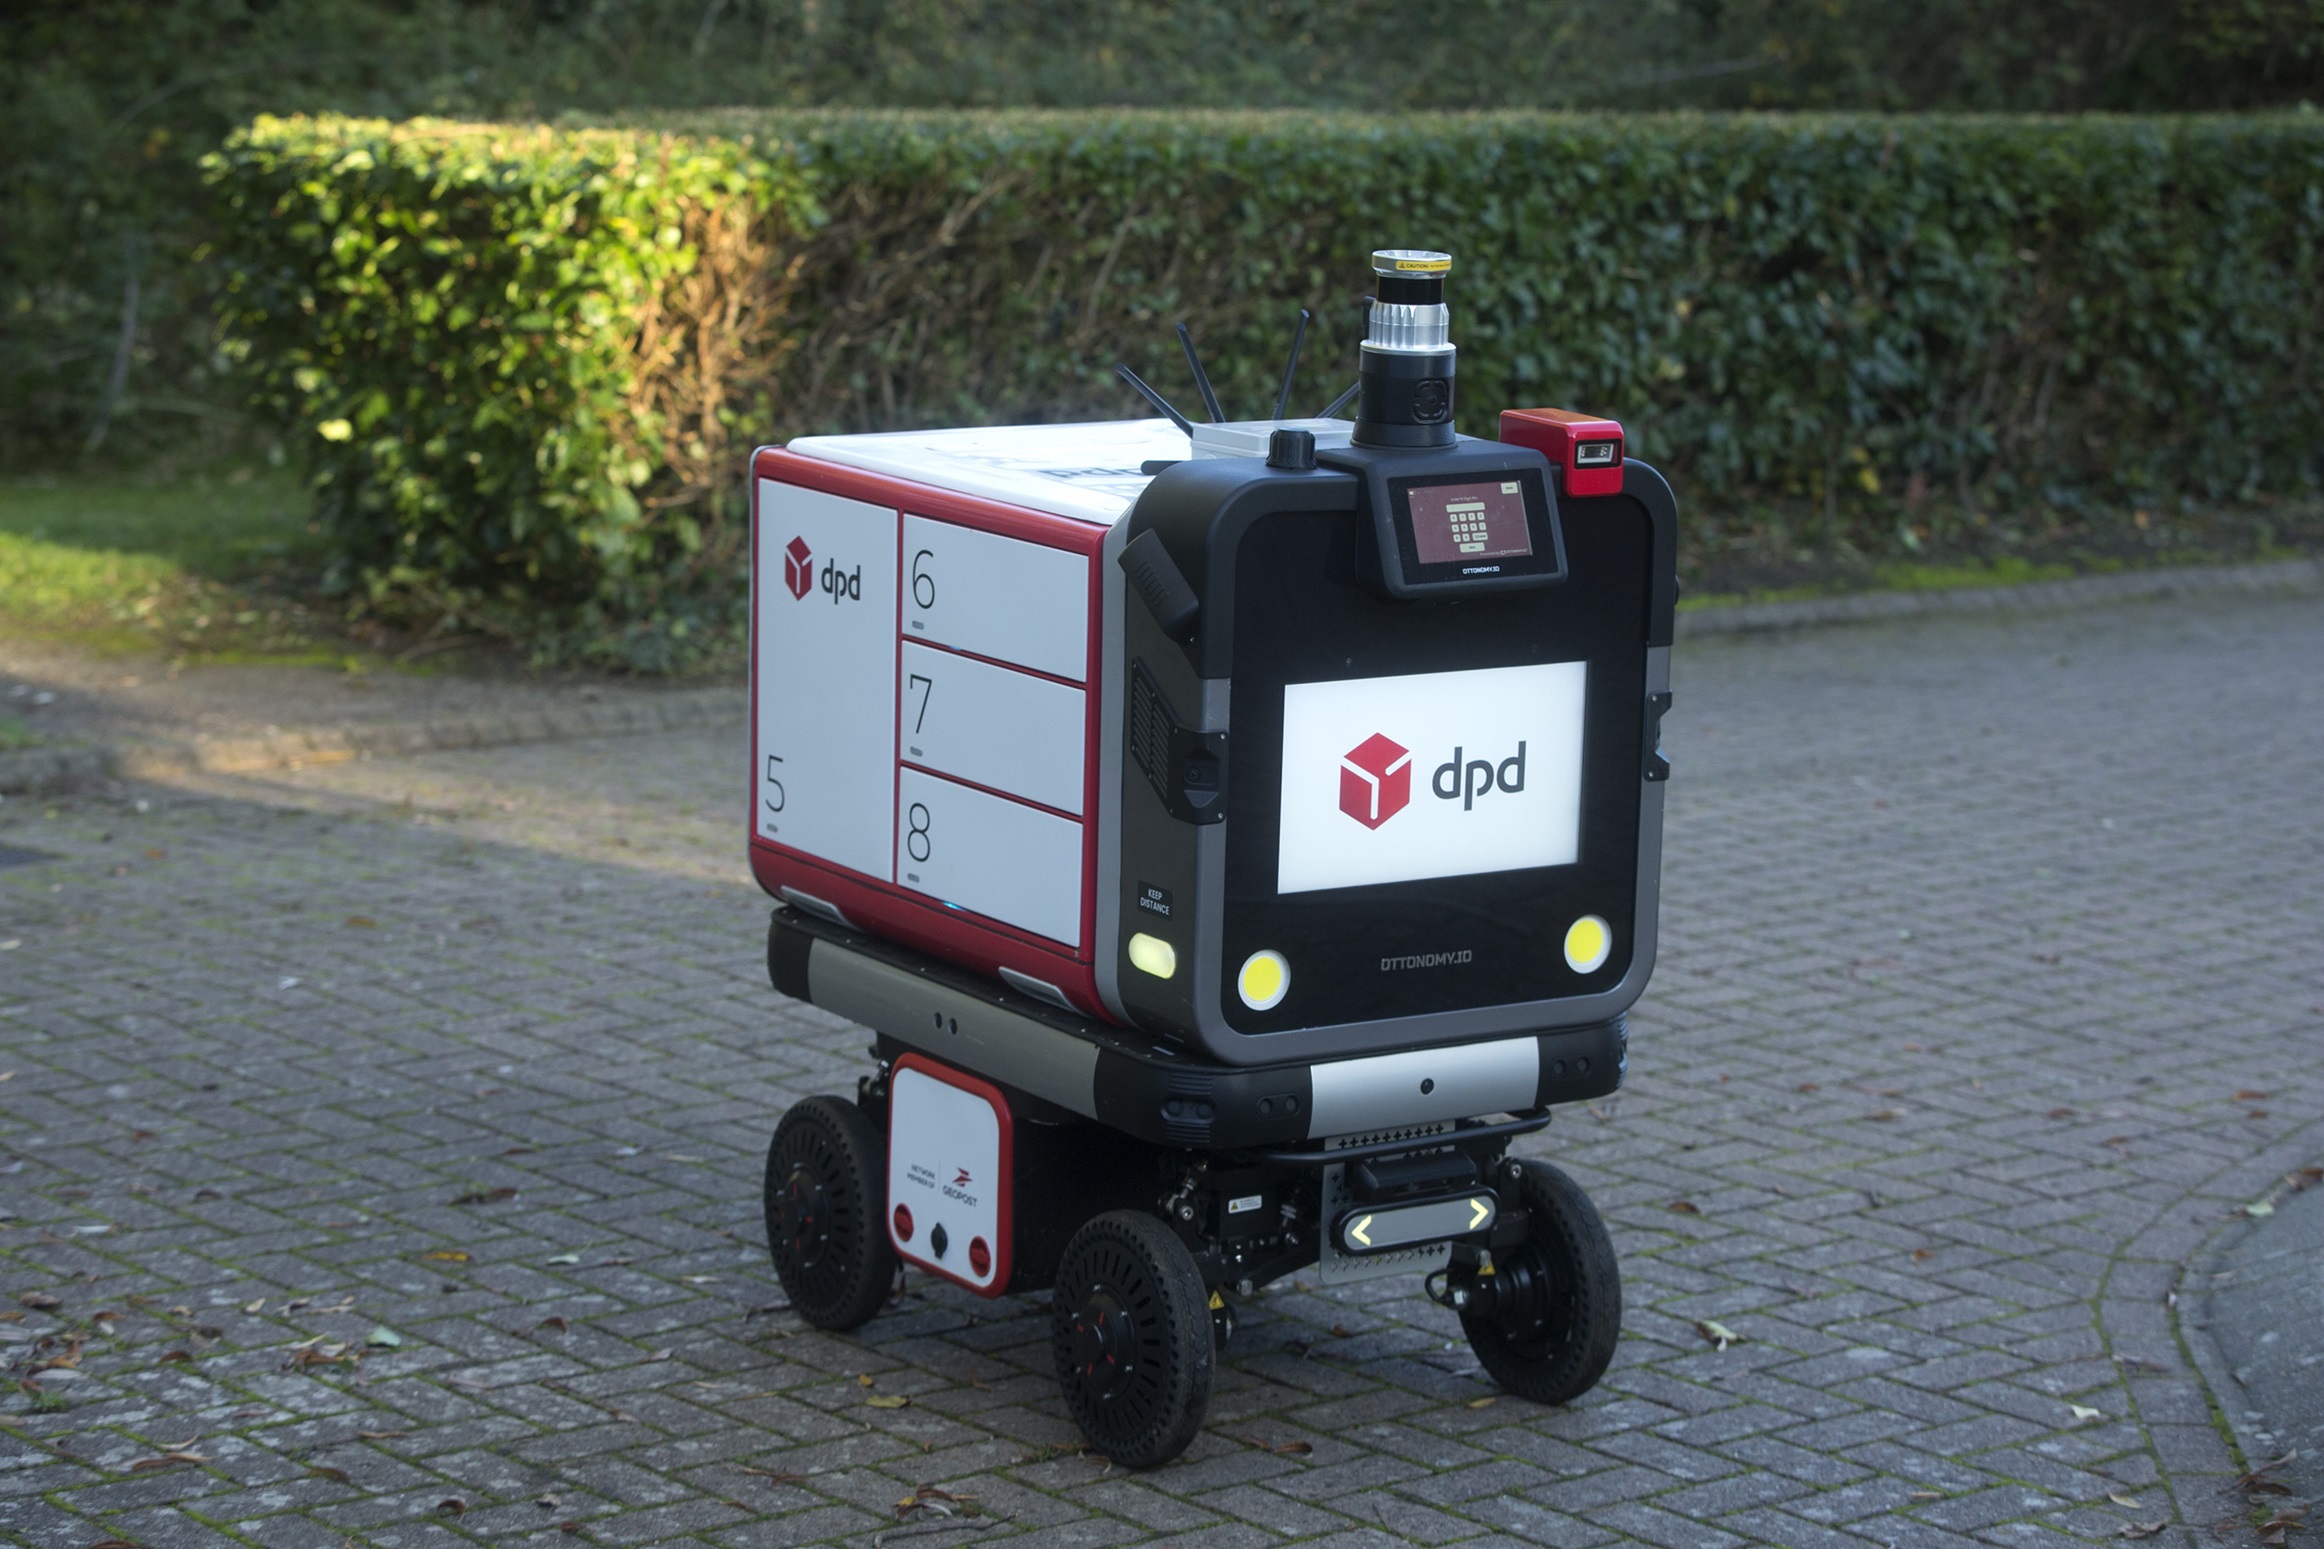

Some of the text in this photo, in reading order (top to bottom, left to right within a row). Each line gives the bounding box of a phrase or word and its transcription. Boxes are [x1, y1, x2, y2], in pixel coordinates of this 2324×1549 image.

[821, 557, 861, 605] dpd
[912, 549, 935, 610] 6
[910, 673, 932, 734] 7
[765, 754, 785, 812] 5
[1432, 740, 1526, 811] dpd
[907, 802, 931, 862] 8
[1140, 896, 1169, 915] DISTANCE
[1148, 888, 1163, 900] KEEP
[1381, 949, 1472, 971] OTTONOMY.IO
[907, 1172, 928, 1186] MEMBER
[911, 1163, 935, 1179] NETWORK
[942, 1185, 978, 1207] GEOPOST
